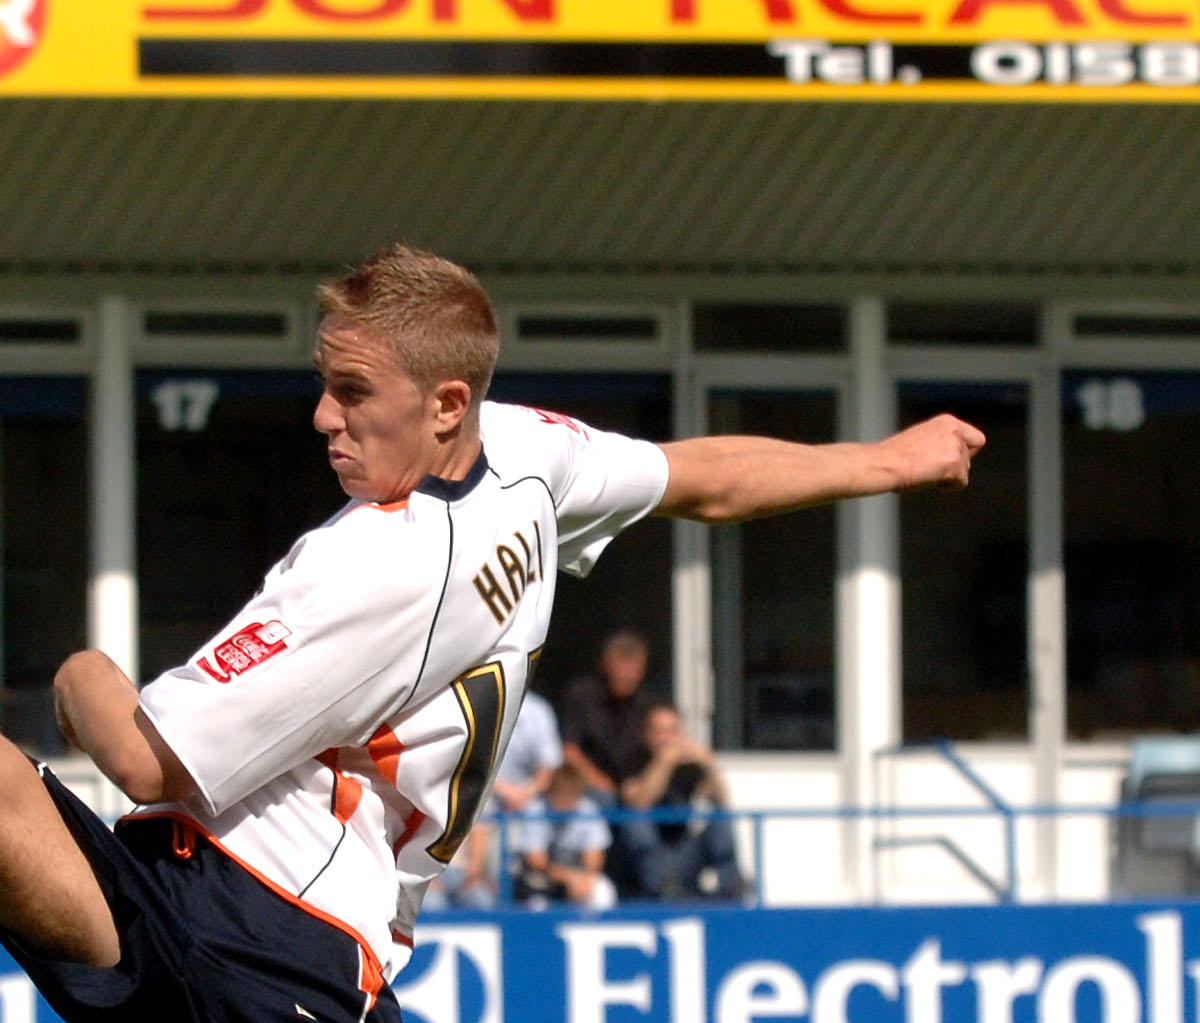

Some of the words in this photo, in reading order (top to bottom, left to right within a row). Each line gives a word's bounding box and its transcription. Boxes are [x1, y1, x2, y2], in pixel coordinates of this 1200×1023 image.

[767, 39, 922, 85] Tel.
[152, 380, 218, 431] 17
[1077, 380, 1144, 431] 18
